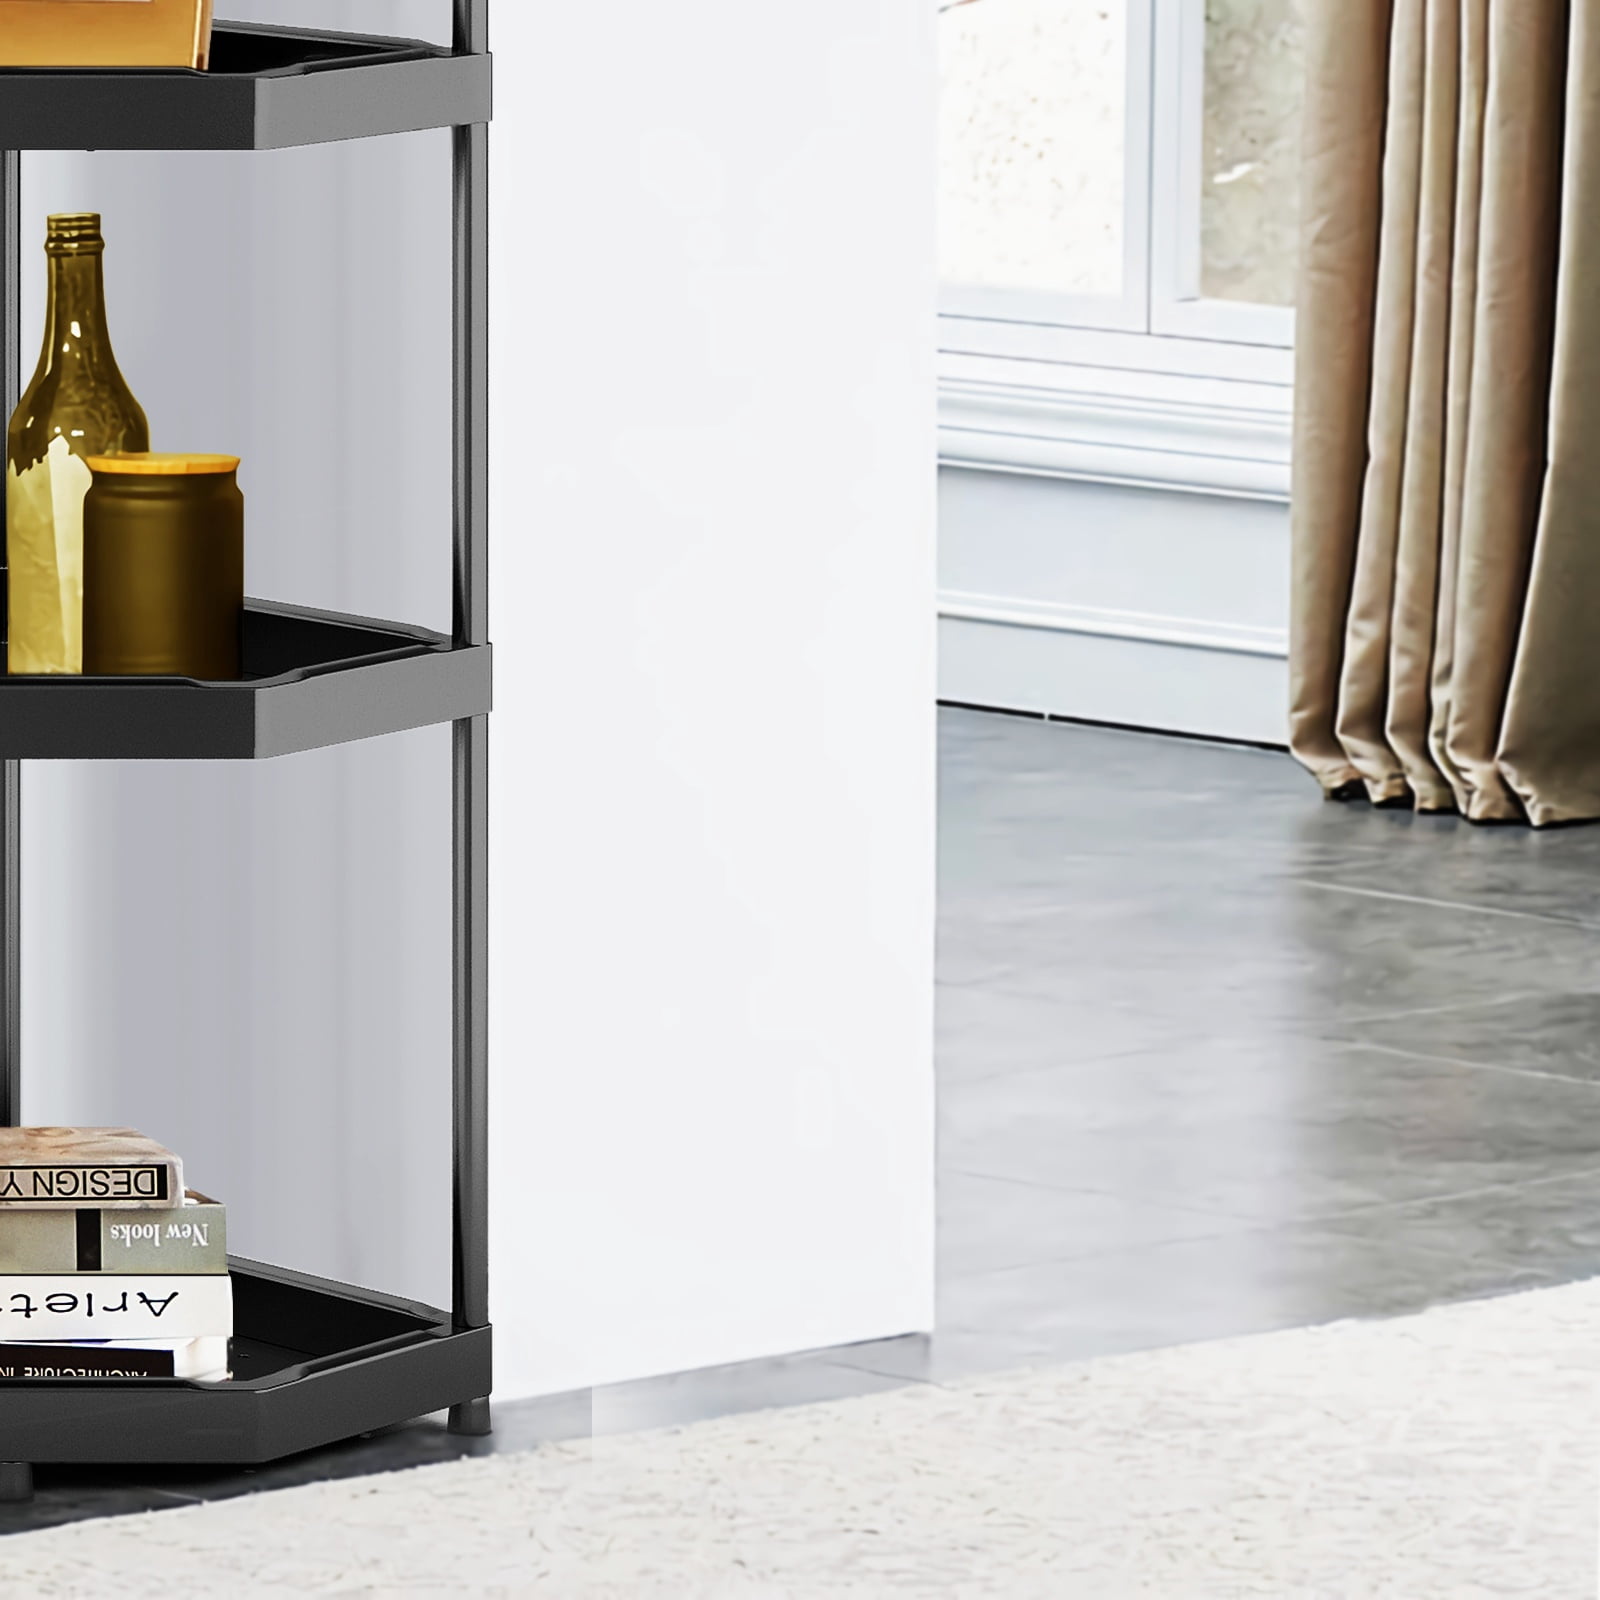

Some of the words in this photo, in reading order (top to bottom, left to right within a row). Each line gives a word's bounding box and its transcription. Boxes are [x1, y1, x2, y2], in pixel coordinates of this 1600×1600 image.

[33, 1170, 155, 1196] DESIGN
[110, 1223, 160, 1247] looks
[165, 1223, 209, 1247] New
